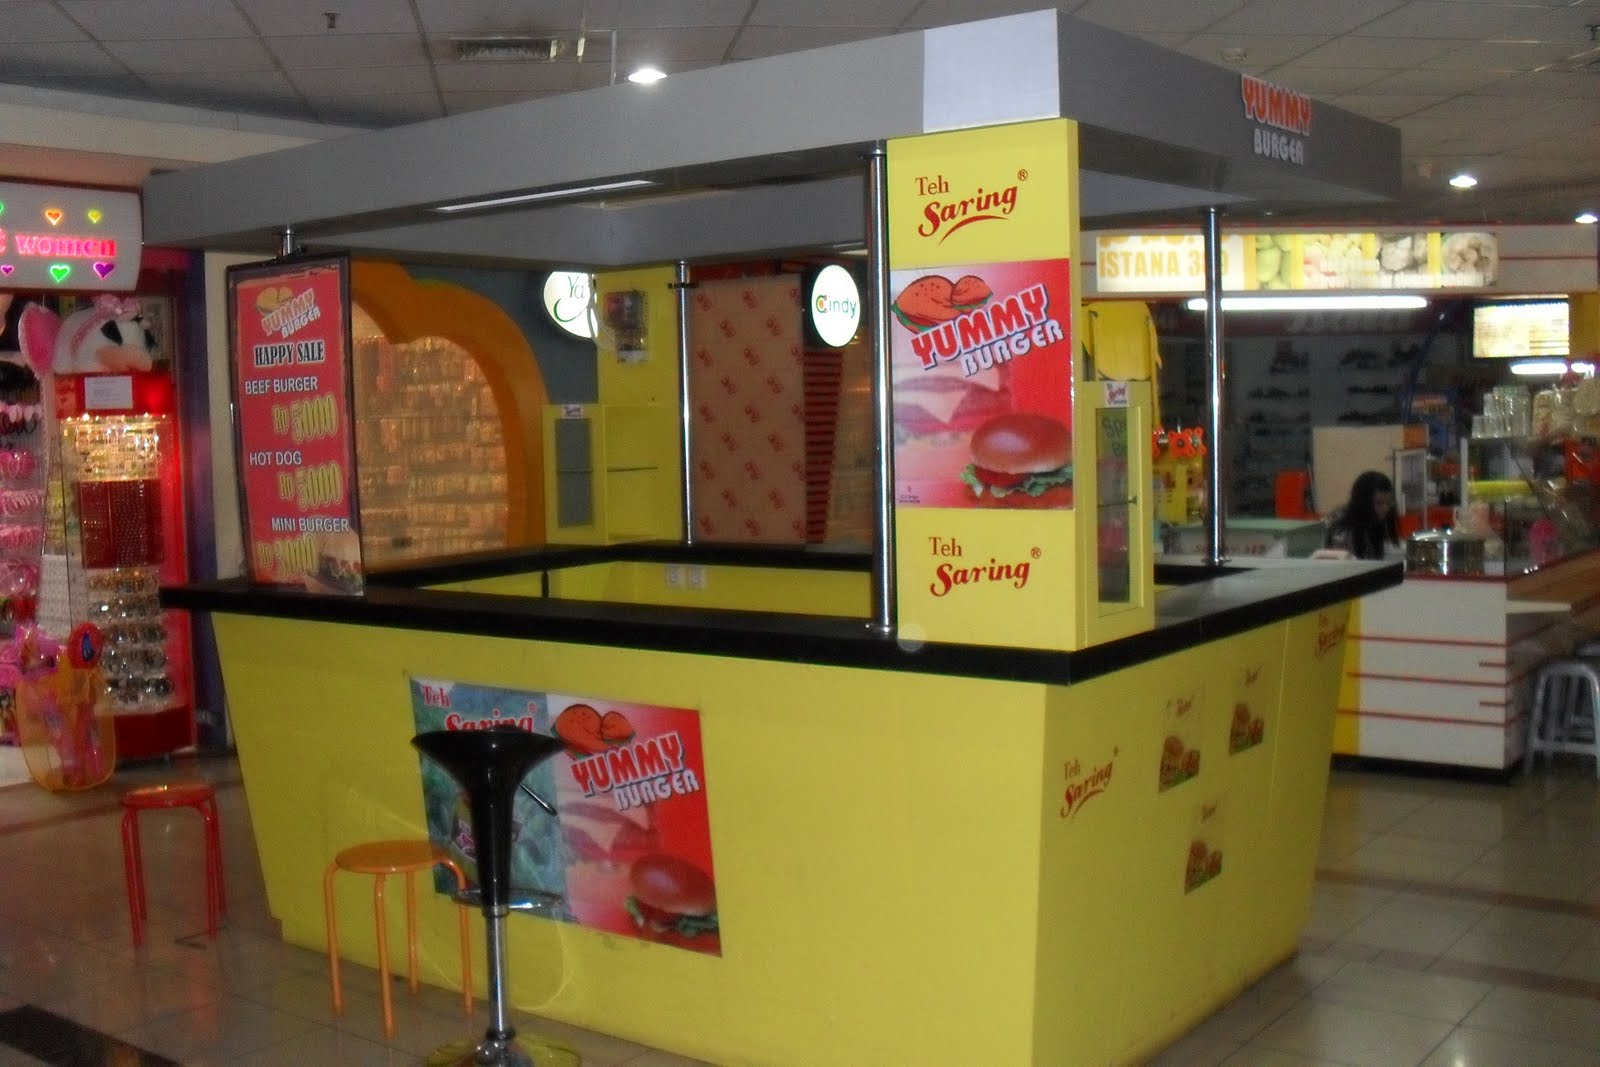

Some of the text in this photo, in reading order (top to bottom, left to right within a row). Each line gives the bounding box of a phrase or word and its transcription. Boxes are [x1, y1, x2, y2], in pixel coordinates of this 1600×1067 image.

[1241, 73, 1312, 137] YUMMY
[1254, 129, 1304, 165] BURGER
[915, 174, 950, 196] Teh
[917, 185, 1018, 238] Saring
[1100, 250, 1181, 278] ISTANA
[262, 289, 315, 336] YUMMY
[280, 305, 321, 339] BURGER
[815, 294, 857, 319] Cindy
[910, 283, 1050, 370] YUMMY
[255, 341, 325, 367] HAPPY SALE
[960, 319, 1065, 377] BURGER
[244, 376, 318, 395] BEEF BURGER
[249, 450, 302, 466] HOT DOG
[271, 517, 350, 533] MINI BURGER
[928, 536, 962, 557] Teh
[930, 558, 1030, 597] Saring
[421, 684, 450, 709] Teh
[571, 733, 685, 797] YUMMY
[614, 770, 700, 811] BURGER
[1060, 762, 1113, 819] Saring
